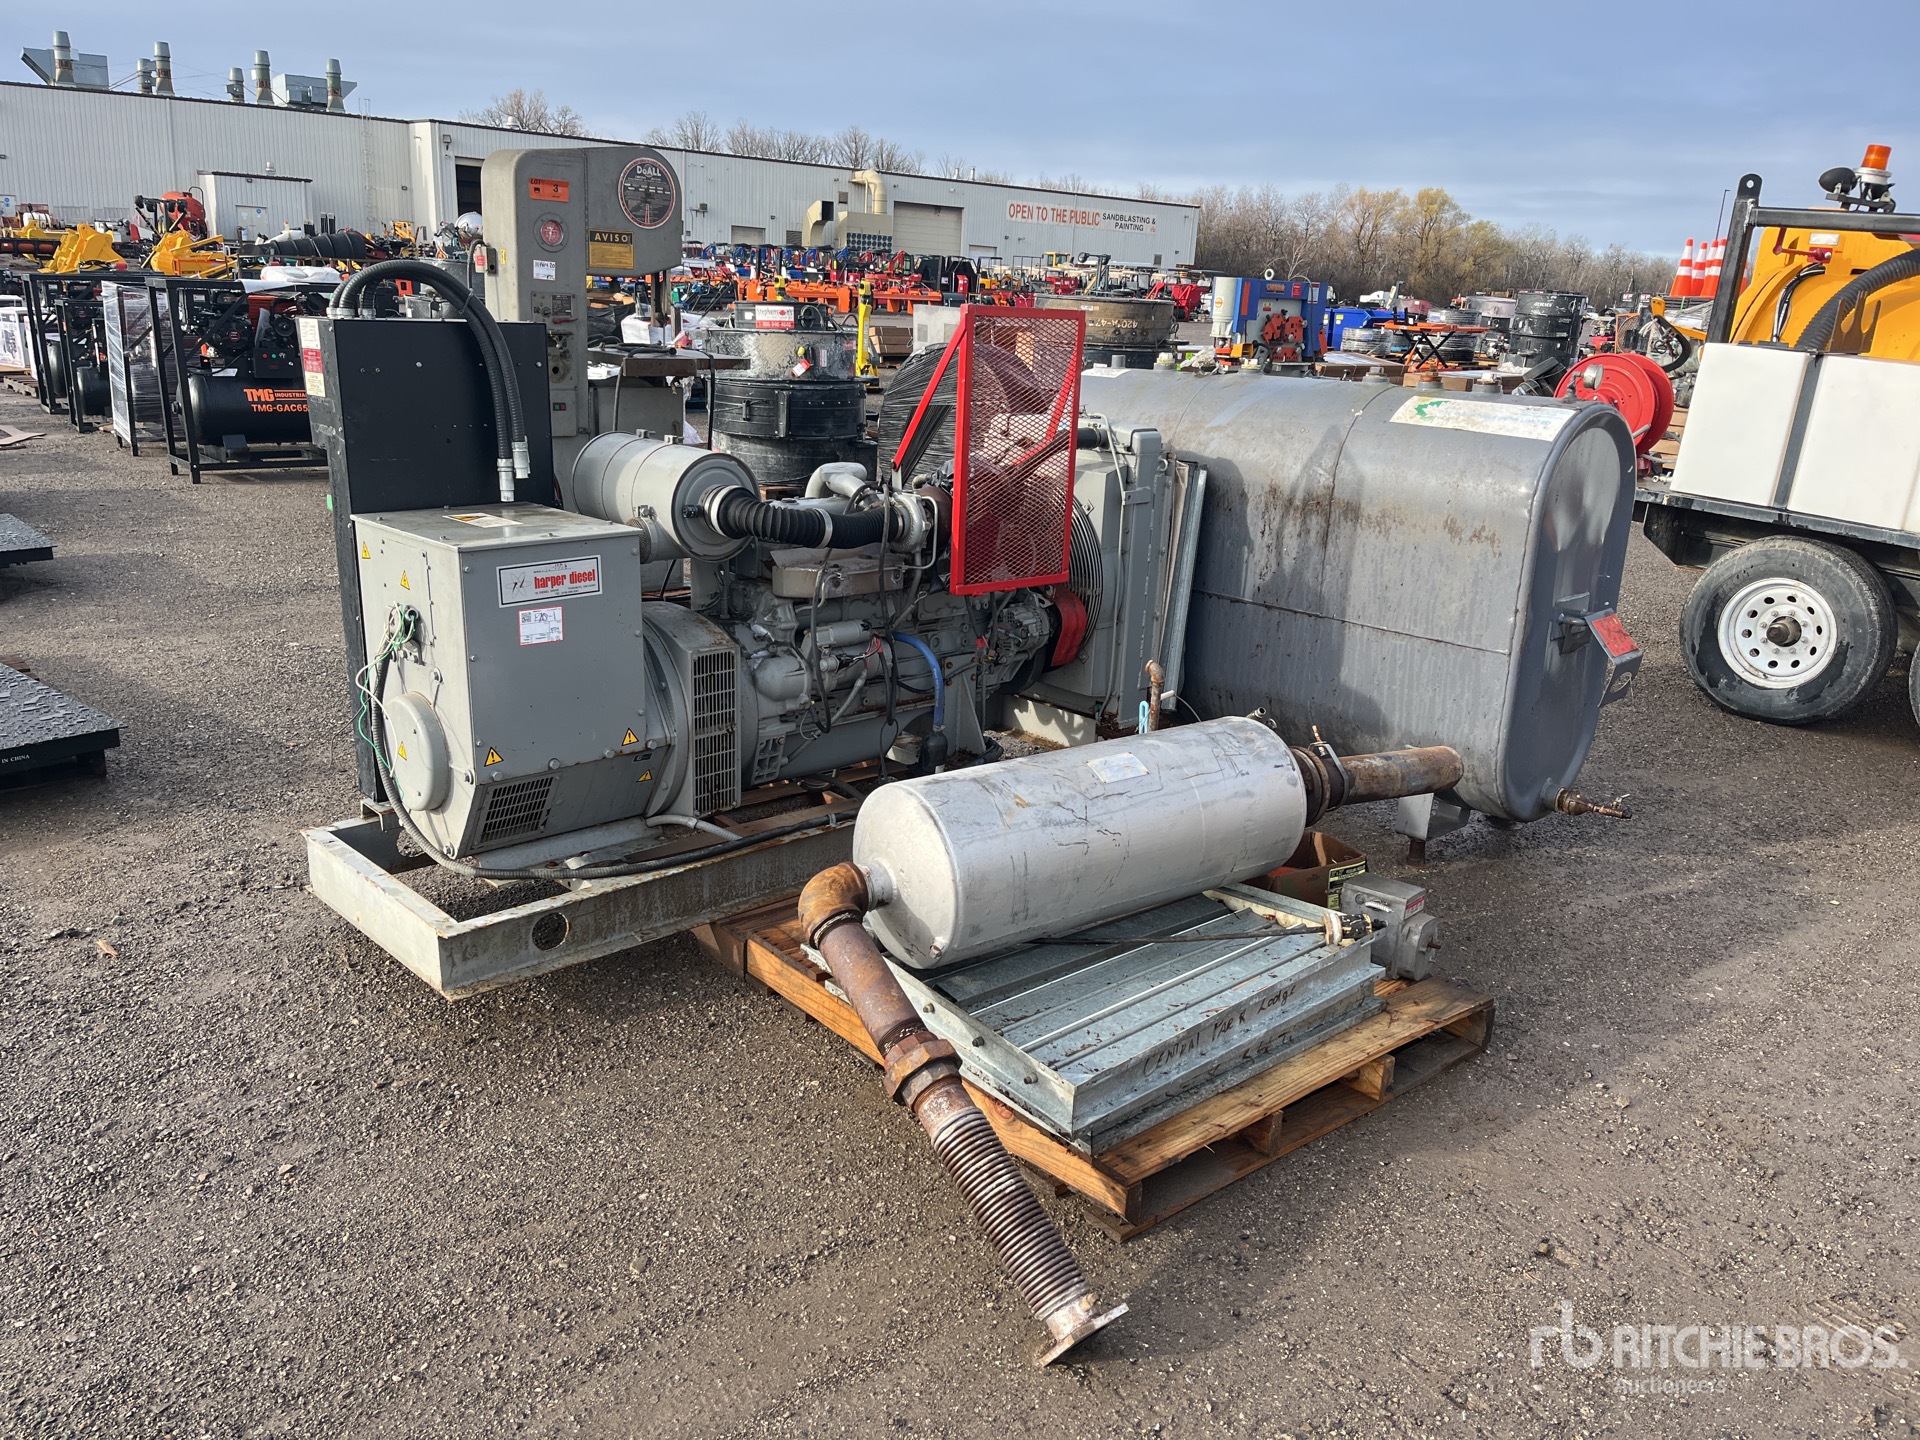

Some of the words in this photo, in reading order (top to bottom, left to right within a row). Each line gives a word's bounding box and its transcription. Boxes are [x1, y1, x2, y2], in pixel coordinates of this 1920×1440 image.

[636, 165, 662, 177] DoALL
[553, 183, 559, 193] 3
[1008, 203, 1034, 220] OPEN
[1036, 206, 1048, 222] TO
[1051, 208, 1067, 224] THE
[1069, 209, 1100, 227] PUBLIC
[1102, 212, 1151, 224] SANDBLASTING
[1114, 222, 1144, 232] PAINTING
[594, 232, 629, 243] AVISO
[243, 388, 275, 402] TMG
[534, 574, 566, 589] harper
[569, 569, 596, 584] diesel
[10, 754, 30, 762] CHINA
